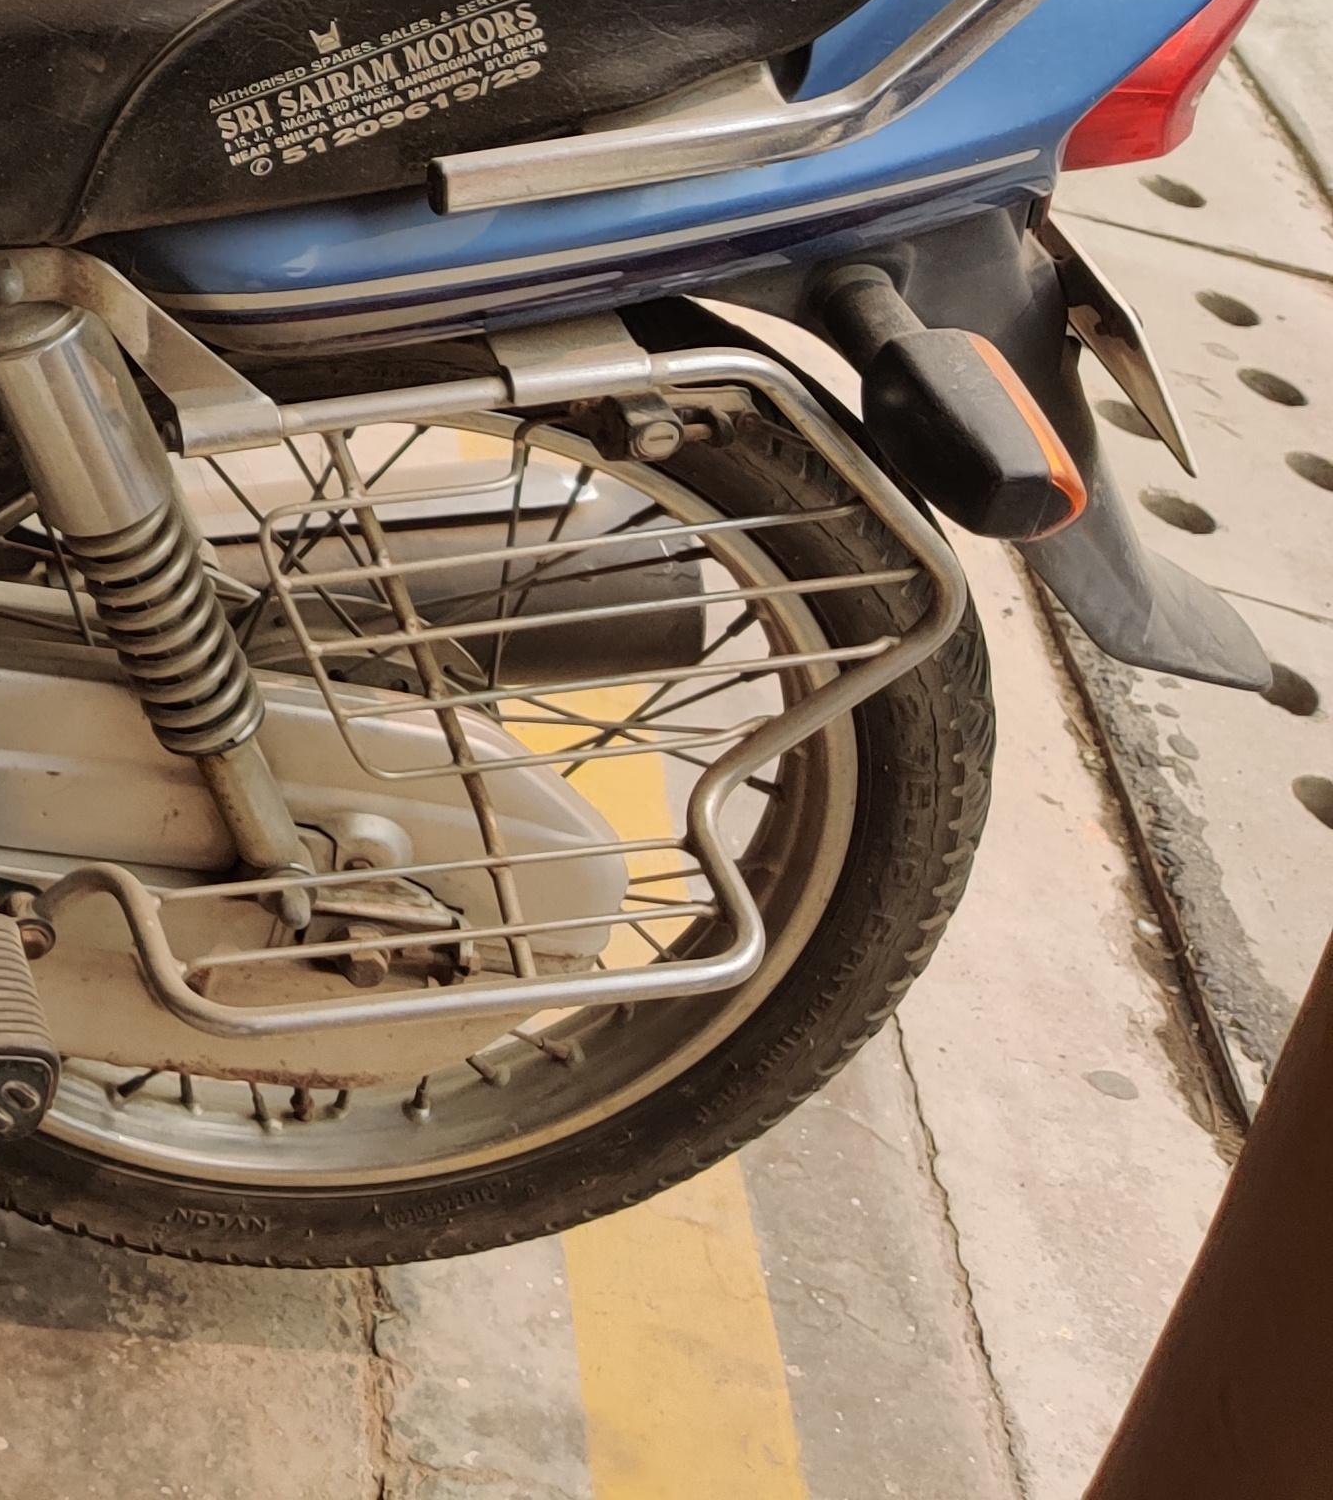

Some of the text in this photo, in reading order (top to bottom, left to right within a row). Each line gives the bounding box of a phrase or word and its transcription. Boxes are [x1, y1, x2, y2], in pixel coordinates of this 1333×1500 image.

[208, 66, 307, 110] AUTHORISED
[440, 11, 452, 23] &
[216, 3, 538, 140] SRI SAIRAM MOTORS
[327, 99, 350, 116] 3RD
[394, 42, 503, 91] BANNERGHATTA
[505, 28, 544, 50] ROAD
[229, 142, 271, 167] NEAR
[274, 121, 330, 150] SHILPA
[333, 94, 405, 128] KALYANA
